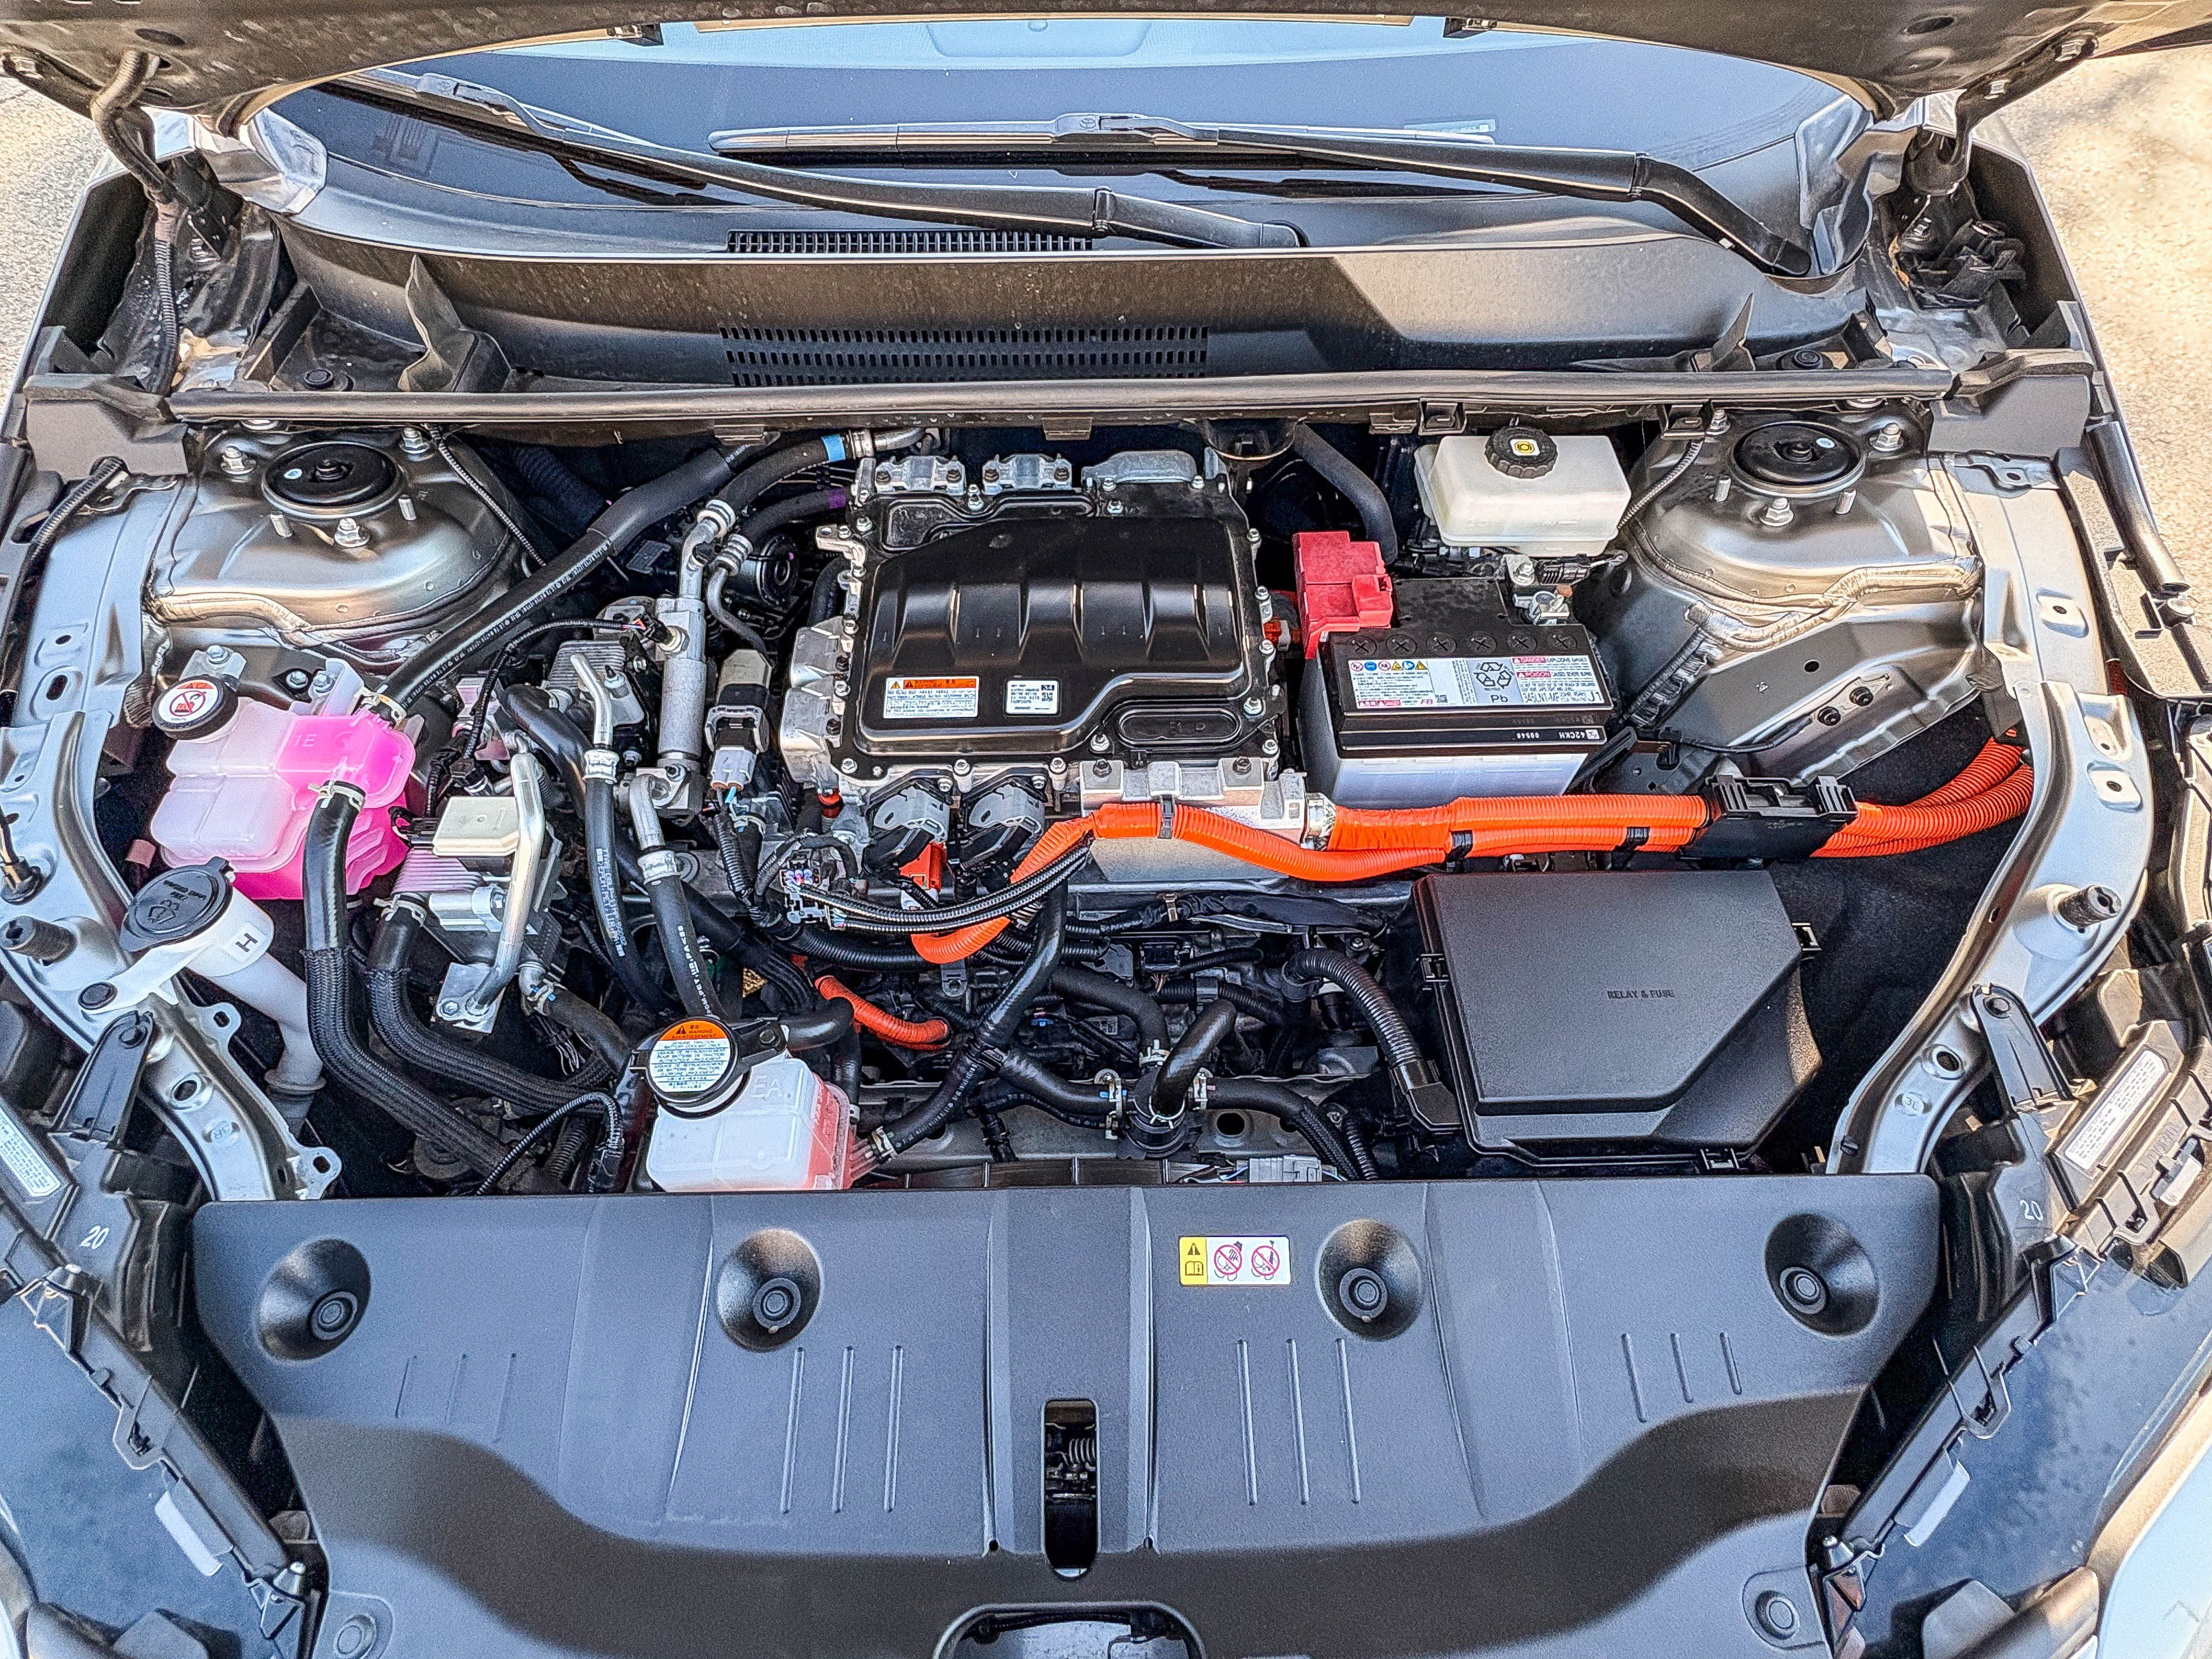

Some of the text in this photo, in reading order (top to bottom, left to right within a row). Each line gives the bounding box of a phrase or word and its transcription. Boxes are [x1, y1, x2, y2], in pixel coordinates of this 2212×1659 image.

[1491, 695, 1508, 703] Pb
[235, 932, 258, 952] H
[1606, 990, 1639, 1000] RELAY
[1640, 990, 1649, 998] &
[2019, 1199, 2044, 1221] 20
[80, 1225, 110, 1250] 20
